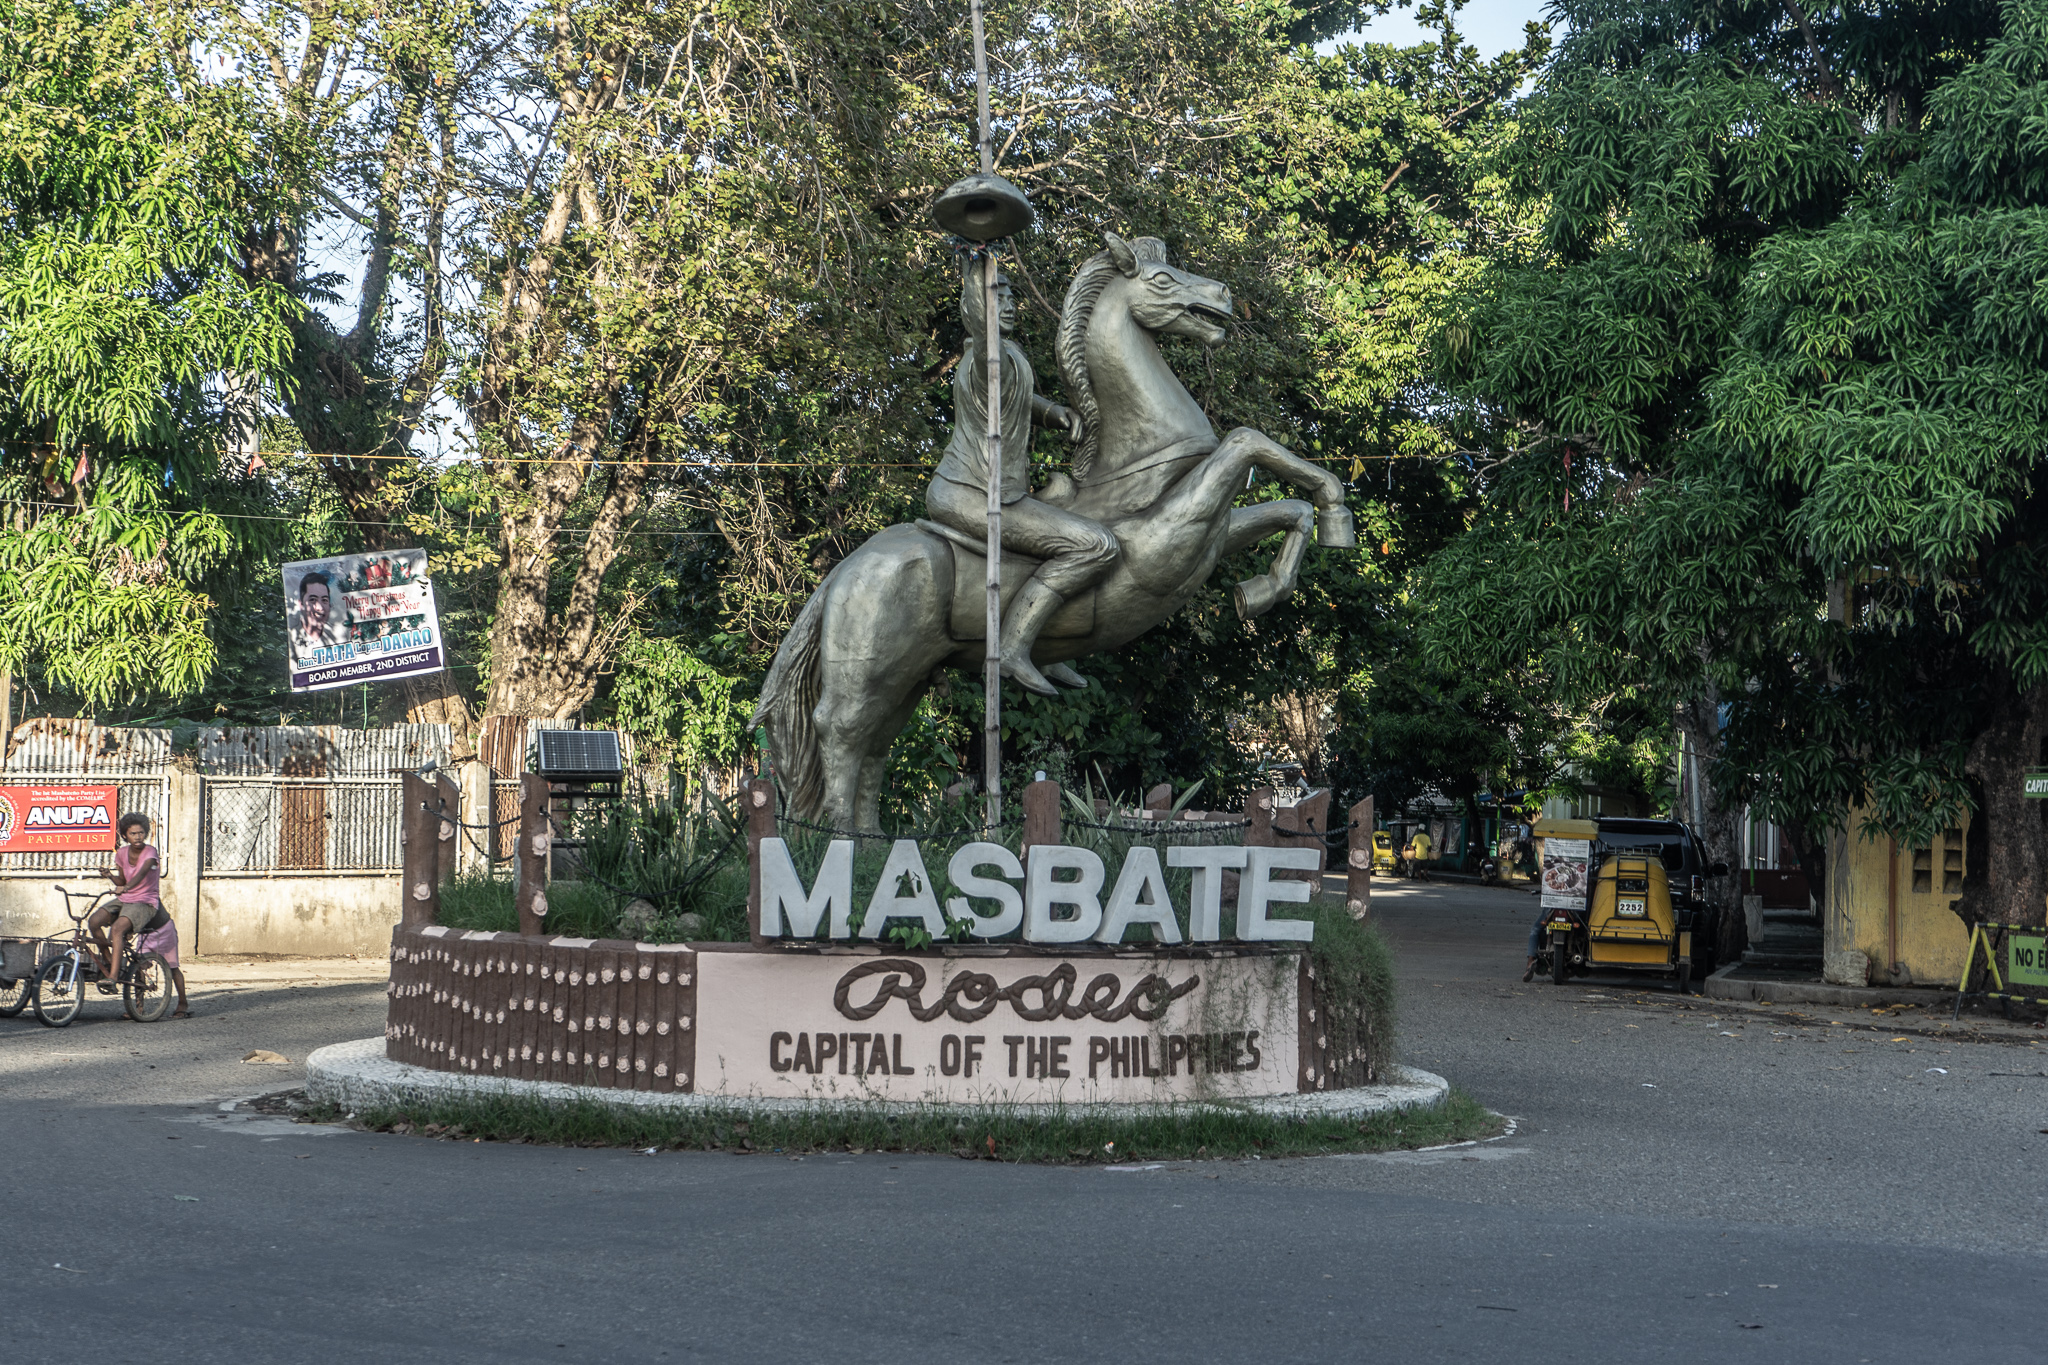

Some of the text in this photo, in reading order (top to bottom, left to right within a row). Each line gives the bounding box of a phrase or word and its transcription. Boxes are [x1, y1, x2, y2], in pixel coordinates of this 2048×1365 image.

[342, 591, 406, 609] Merry Christmas
[356, 600, 420, 620] Happy New Year
[298, 629, 432, 669] Hon. TATA Lopez DANAO
[309, 652, 429, 682] BOARD MEMBER, 2ND DISTRICT
[2025, 779, 2048, 793] CAPIT
[25, 805, 110, 825] ANUPA
[28, 834, 107, 844] PARTY LIST
[759, 837, 1320, 944] MASBATE
[1620, 903, 1642, 912] 2252
[2015, 947, 2048, 969] NO E
[833, 958, 1199, 1023] Rodeo
[769, 1031, 914, 1076] CAPITAL
[940, 1034, 984, 1077] OF
[1002, 1034, 1070, 1078] THE
